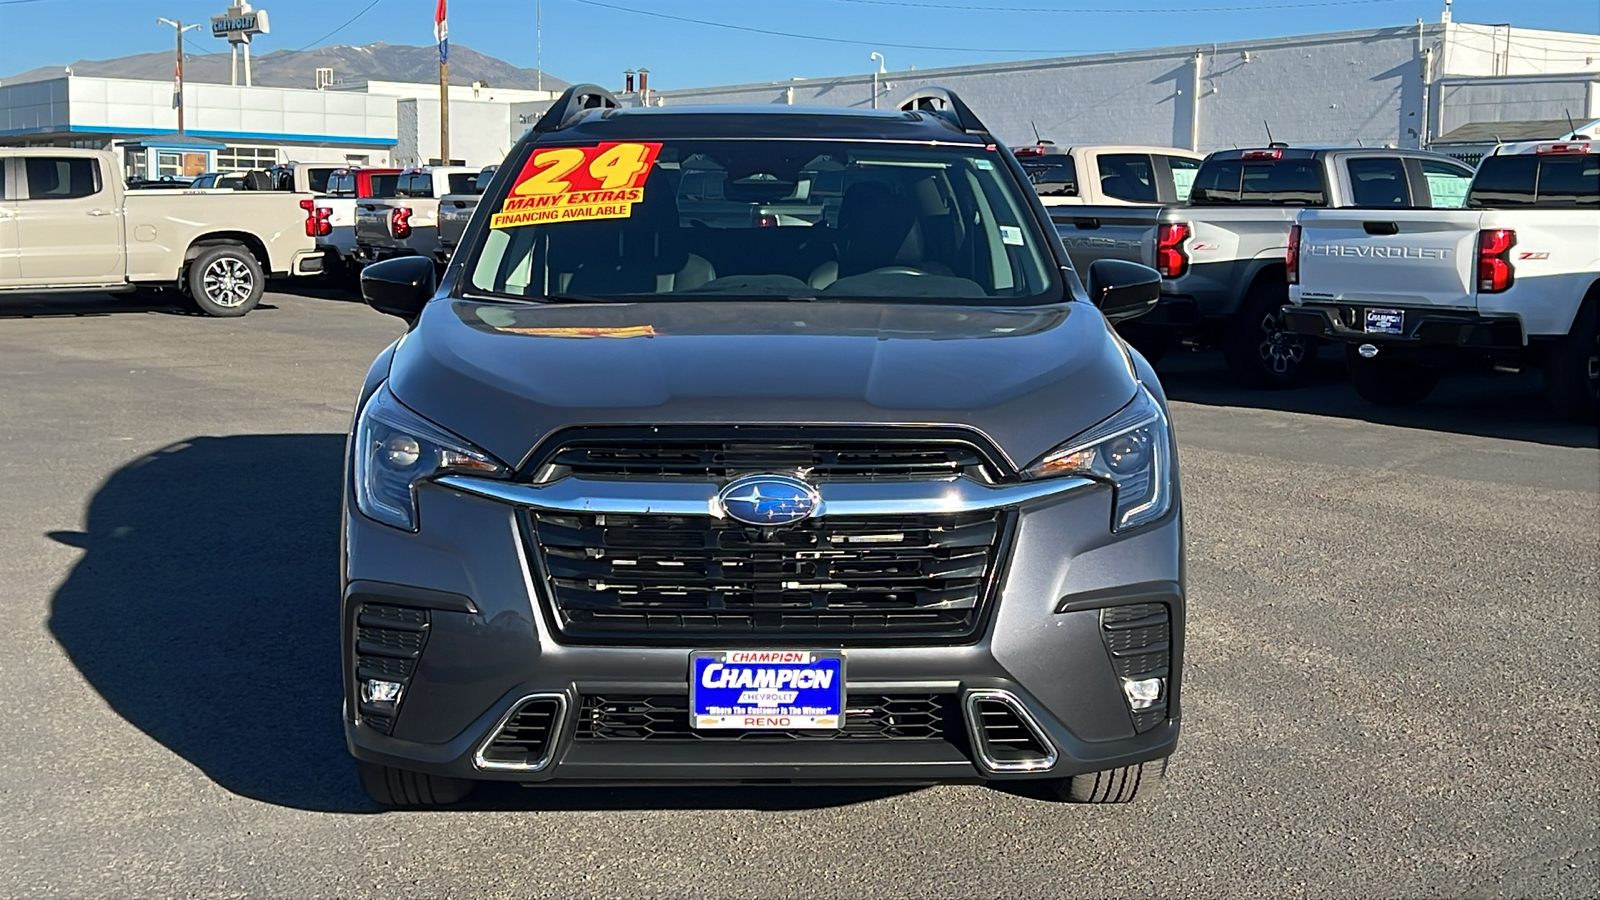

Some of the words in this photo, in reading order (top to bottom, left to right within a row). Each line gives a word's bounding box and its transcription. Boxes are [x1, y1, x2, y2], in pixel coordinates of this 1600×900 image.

[213, 17, 254, 31] CHEVROLET
[515, 143, 650, 196] 24
[505, 194, 563, 211] MANY
[567, 189, 640, 205] EXTRAS
[495, 209, 558, 226] FINANCING
[562, 205, 627, 218] AVAILABLE
[1311, 244, 1453, 260] CHEVROLET
[732, 652, 803, 663] CHAMPION
[701, 663, 834, 689] CHAMPION
[742, 693, 793, 701] CHEVROLET
[744, 717, 791, 727] RENO
